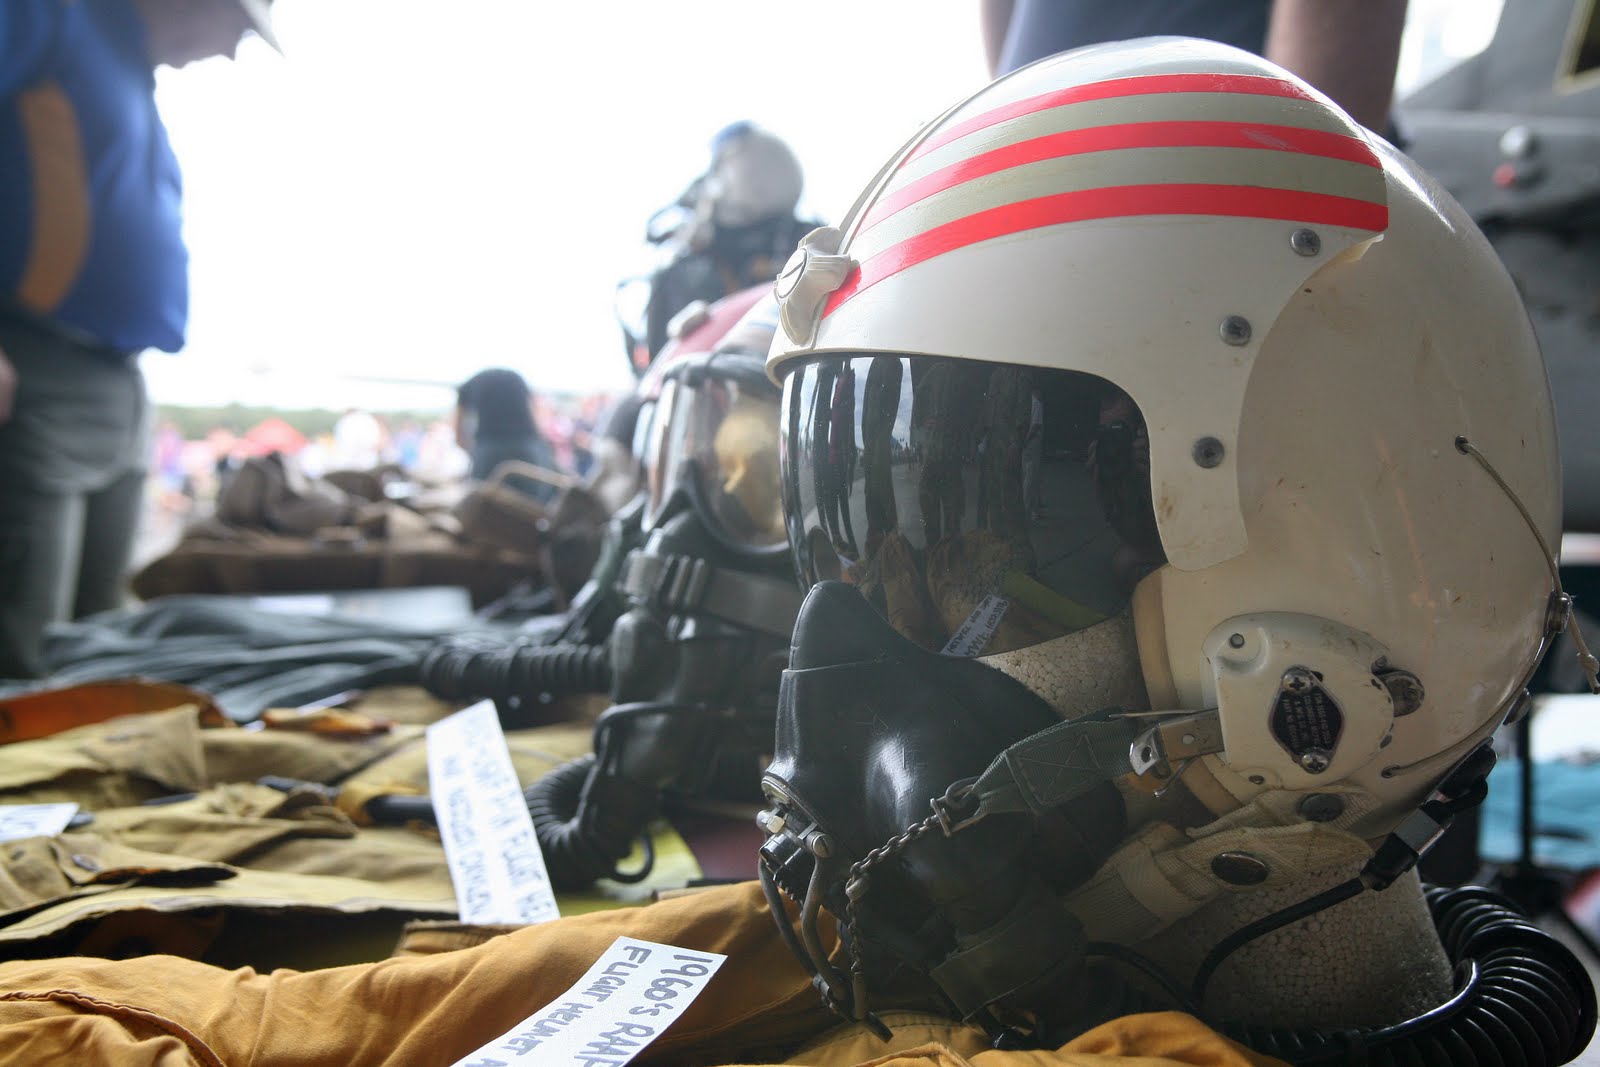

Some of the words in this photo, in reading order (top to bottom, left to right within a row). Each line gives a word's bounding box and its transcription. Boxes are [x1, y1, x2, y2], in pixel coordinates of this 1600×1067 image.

[581, 945, 652, 1002] FLIGHT
[629, 954, 713, 1017] 1960's
[501, 1002, 594, 1056] HELMET
